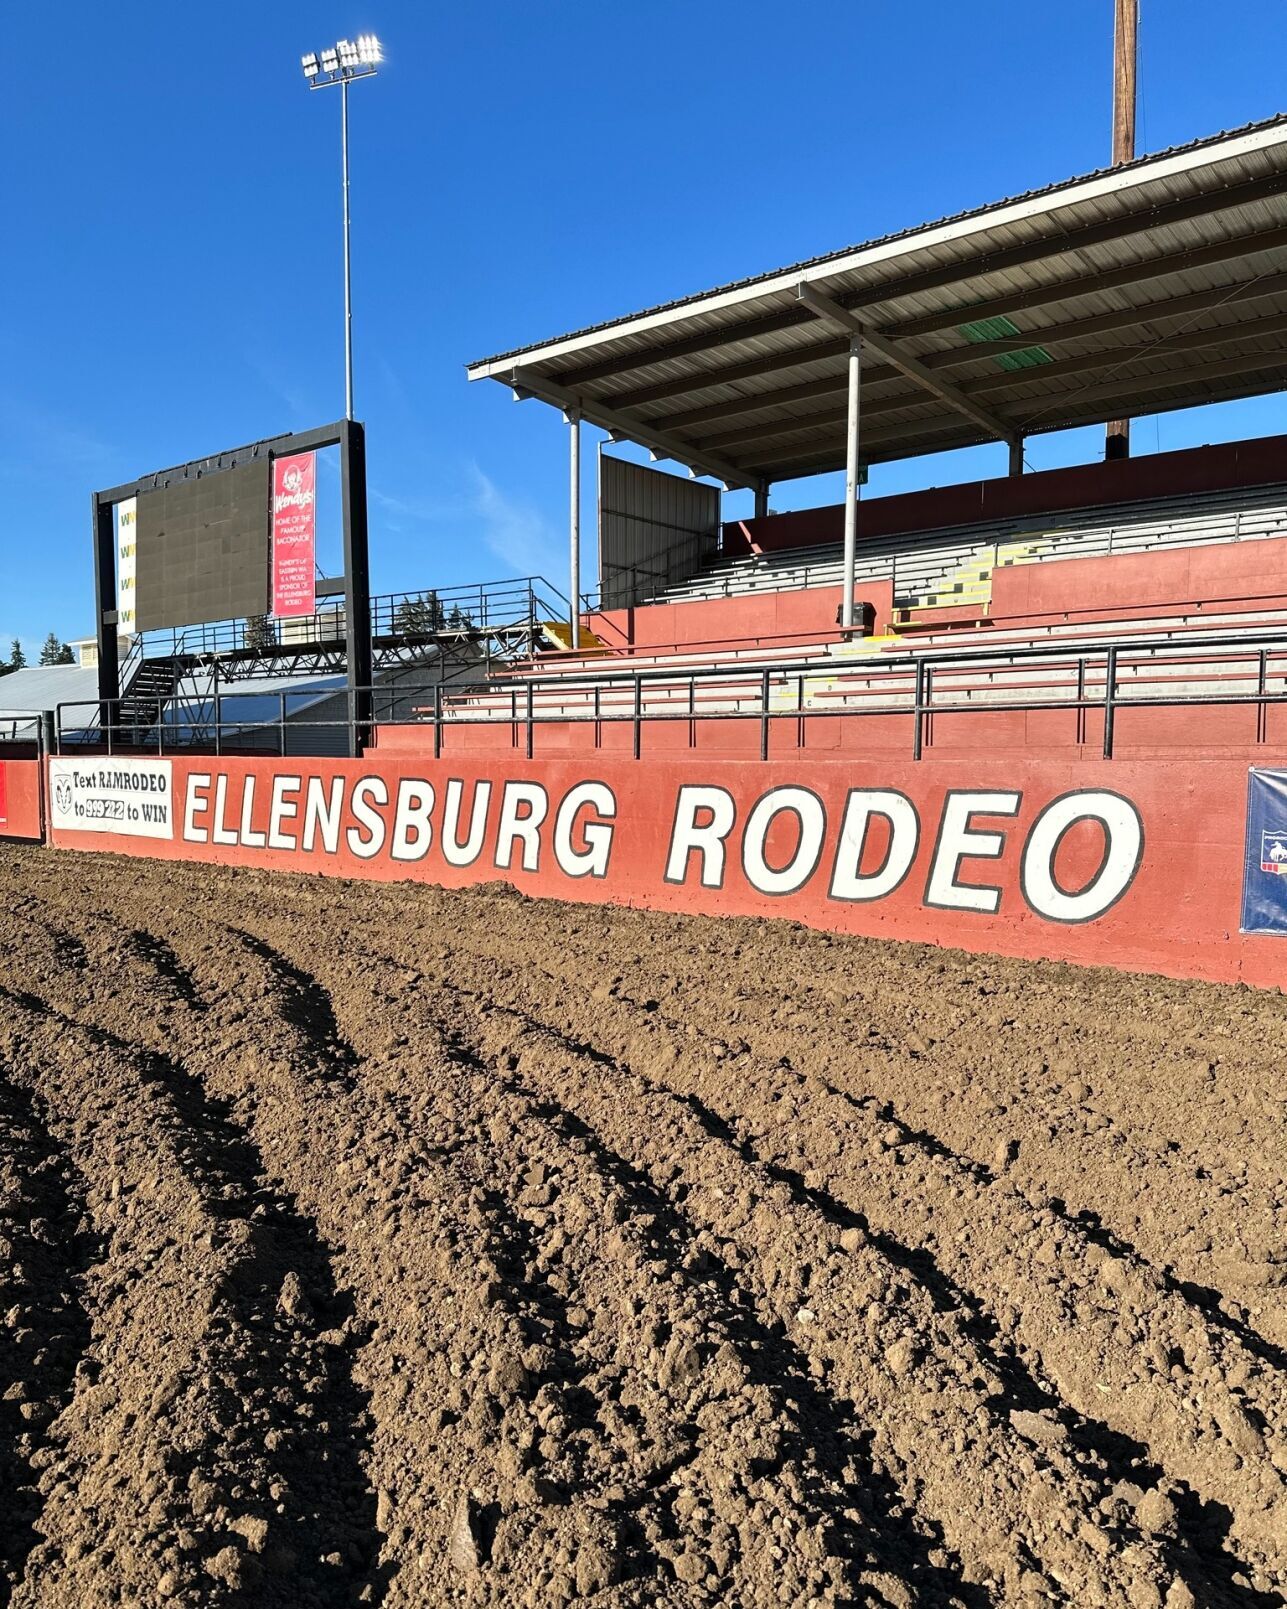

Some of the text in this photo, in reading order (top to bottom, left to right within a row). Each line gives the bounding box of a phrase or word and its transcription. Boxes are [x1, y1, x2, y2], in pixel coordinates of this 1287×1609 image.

[73, 771, 166, 792] Text RAMRODEO
[74, 800, 84, 817] to
[127, 803, 138, 820] to
[141, 803, 167, 824] WIN
[182, 771, 1145, 925] ELLENSBURG RODEO
